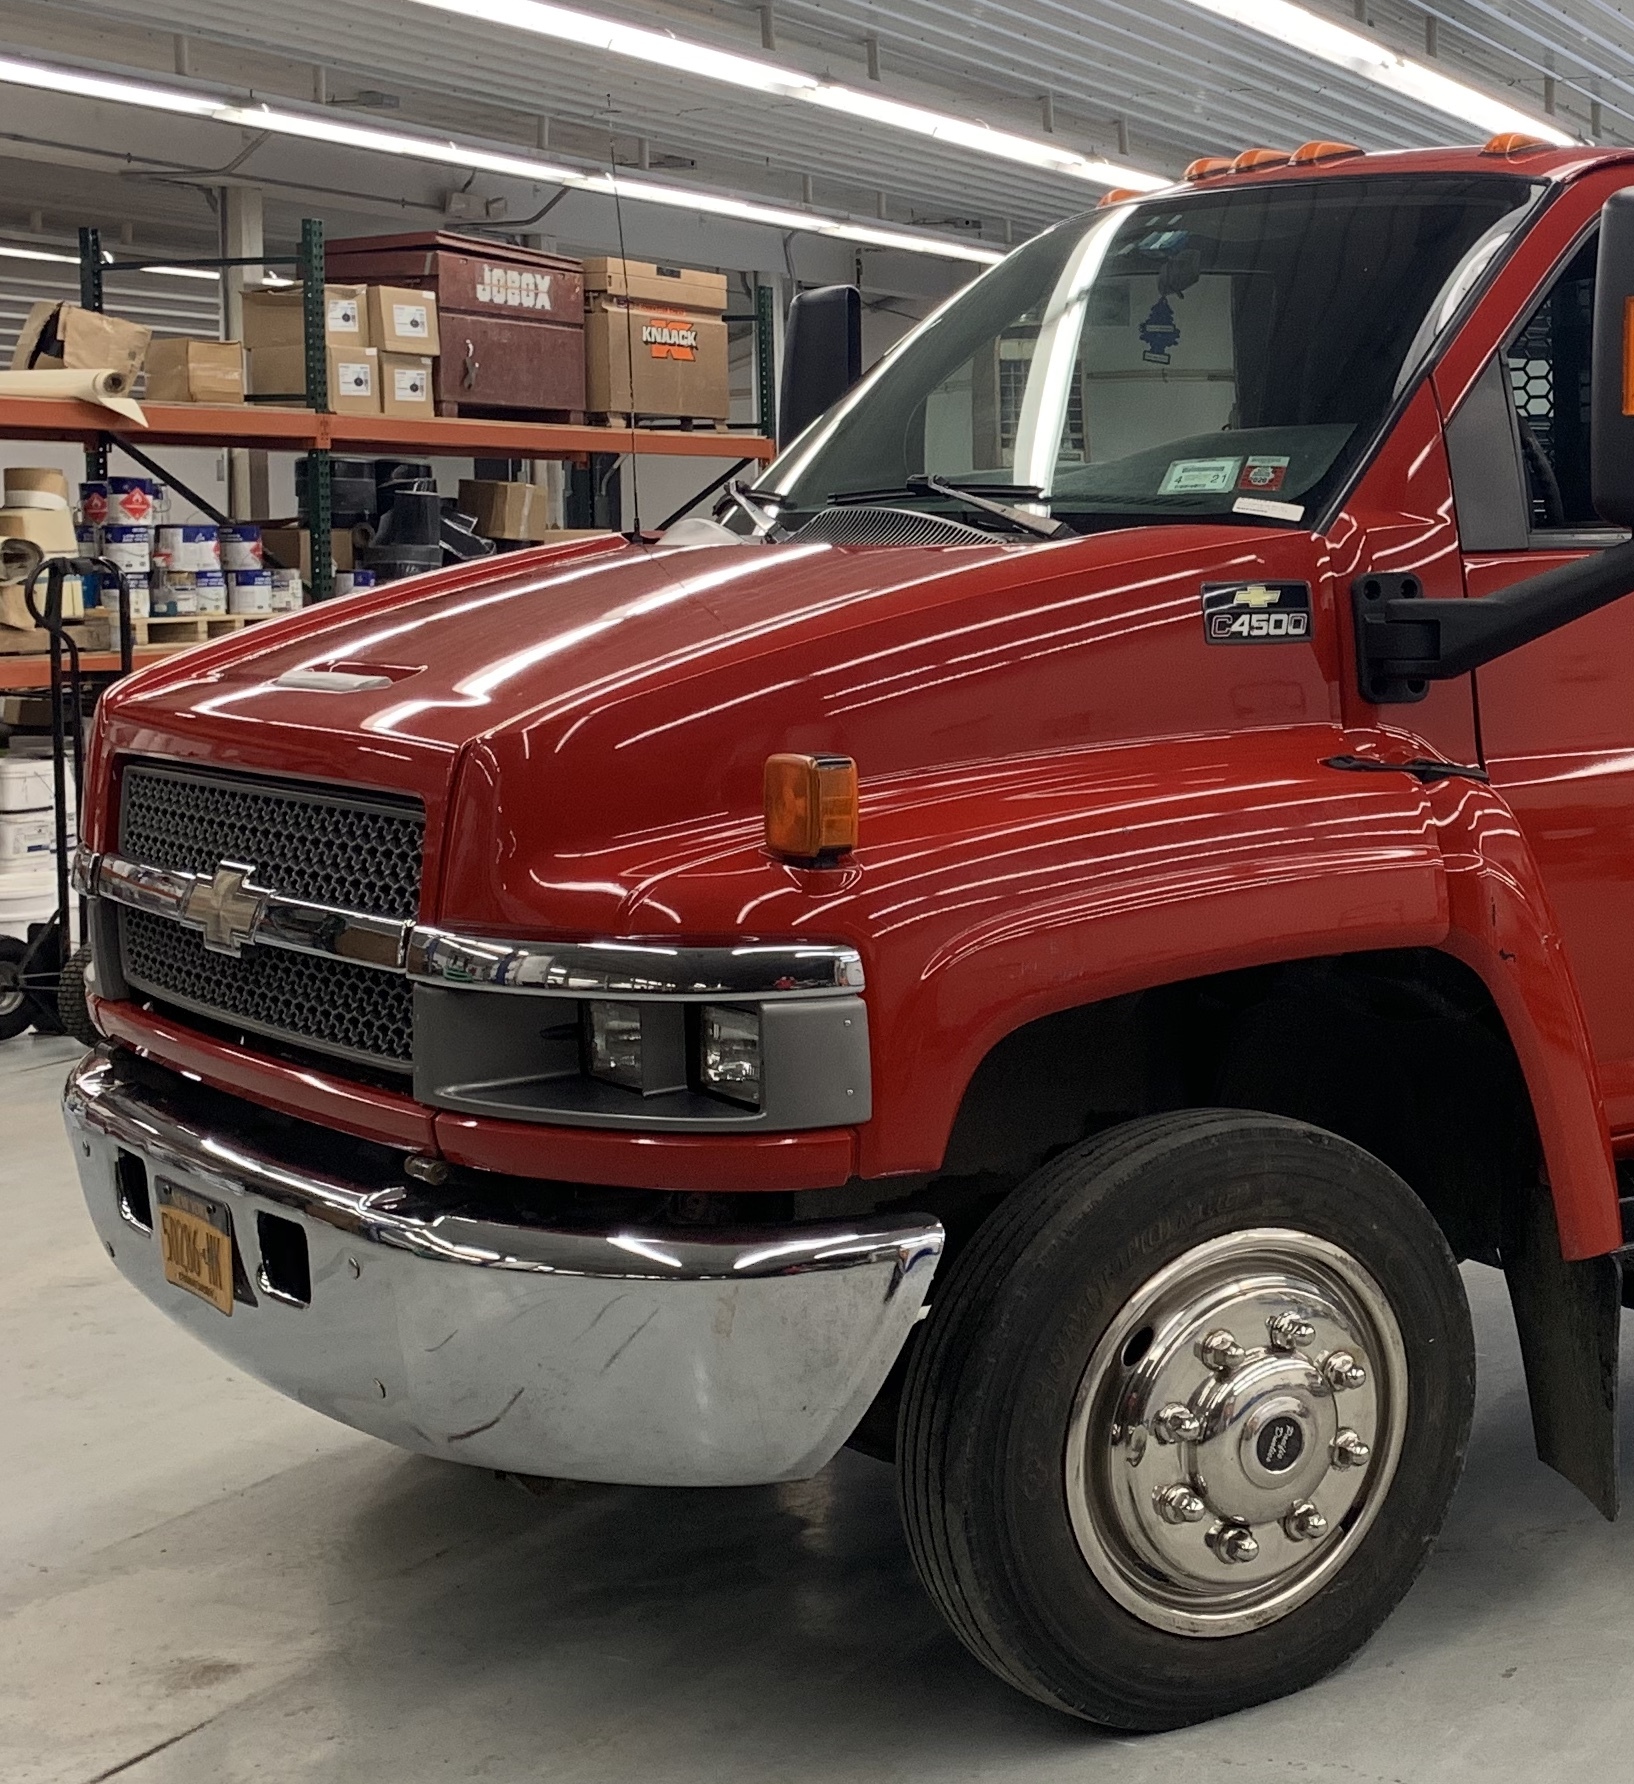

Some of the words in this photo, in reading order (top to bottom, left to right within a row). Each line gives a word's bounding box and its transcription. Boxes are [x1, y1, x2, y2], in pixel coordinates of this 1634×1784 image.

[476, 263, 552, 311] JOBOX
[642, 325, 699, 349] KNAACK
[1211, 613, 1308, 638] C4500
